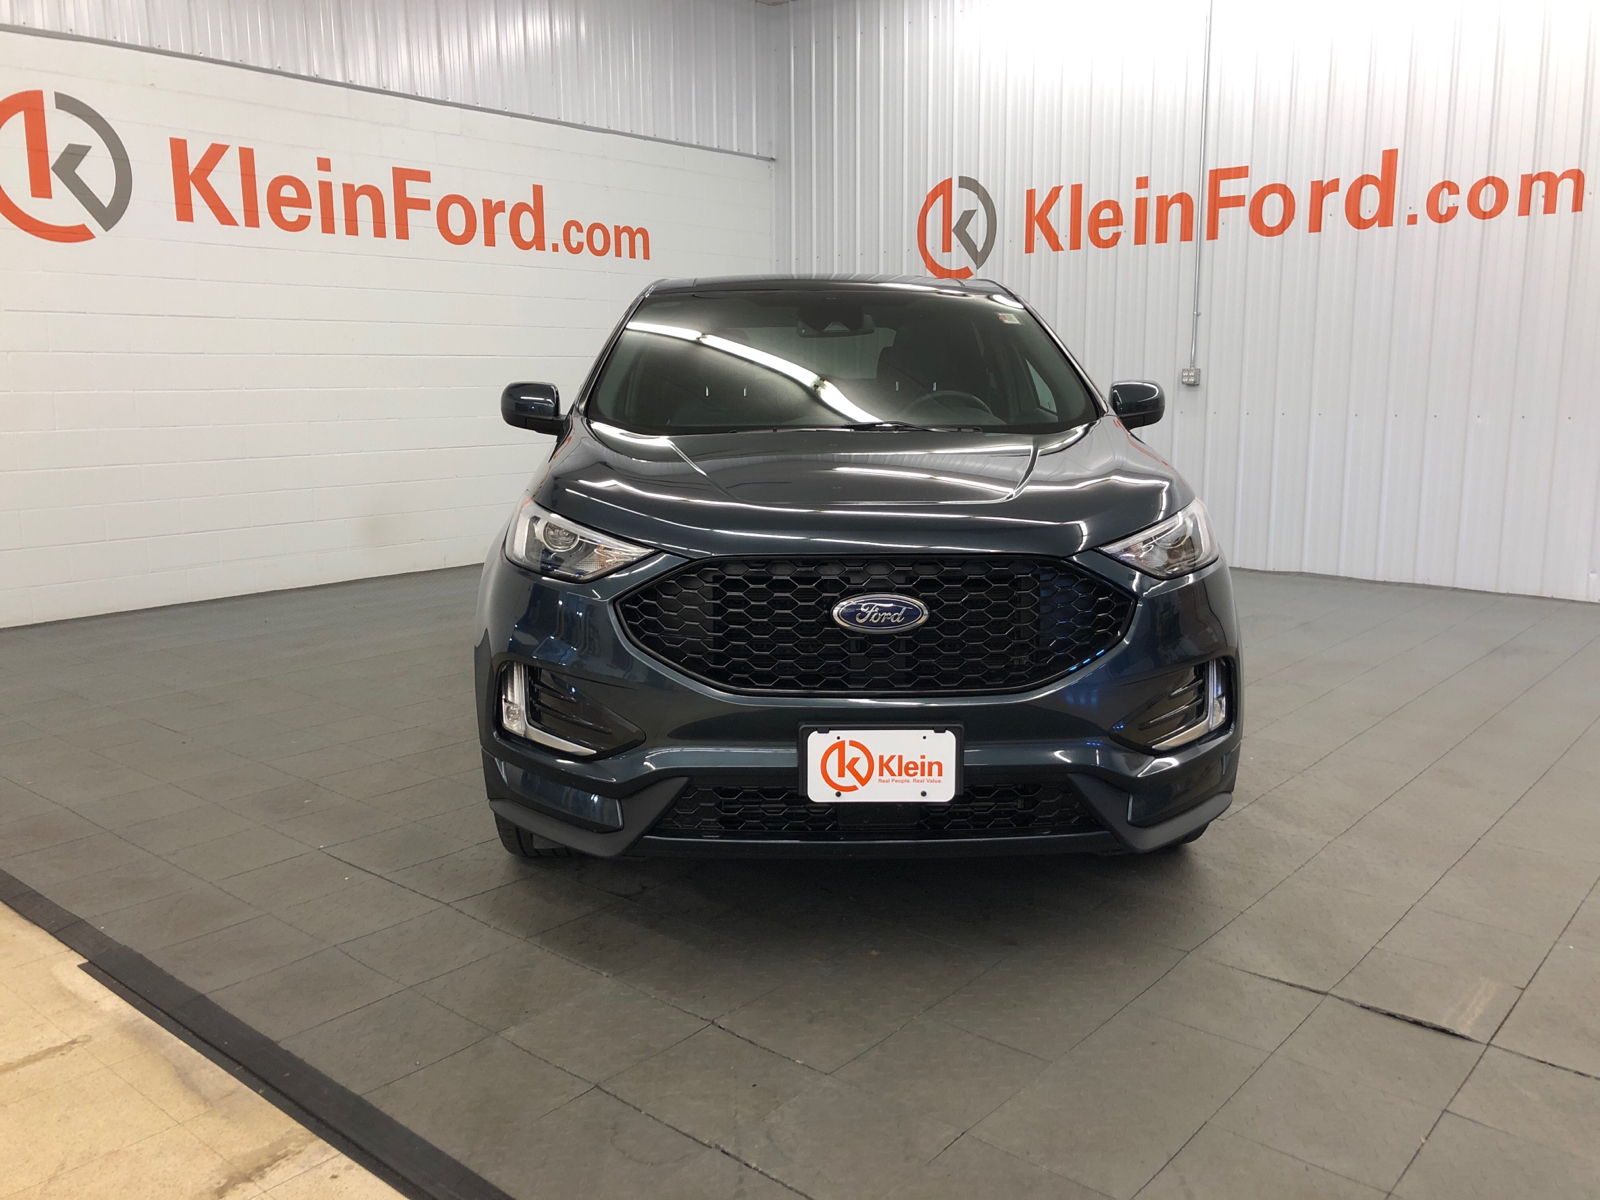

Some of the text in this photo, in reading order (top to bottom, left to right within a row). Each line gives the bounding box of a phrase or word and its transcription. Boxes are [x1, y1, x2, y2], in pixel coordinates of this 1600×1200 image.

[169, 136, 650, 261] KleinFord.com
[1024, 148, 1585, 255] KleinFord.com
[855, 602, 914, 624] Ford
[878, 754, 943, 777] Klein
